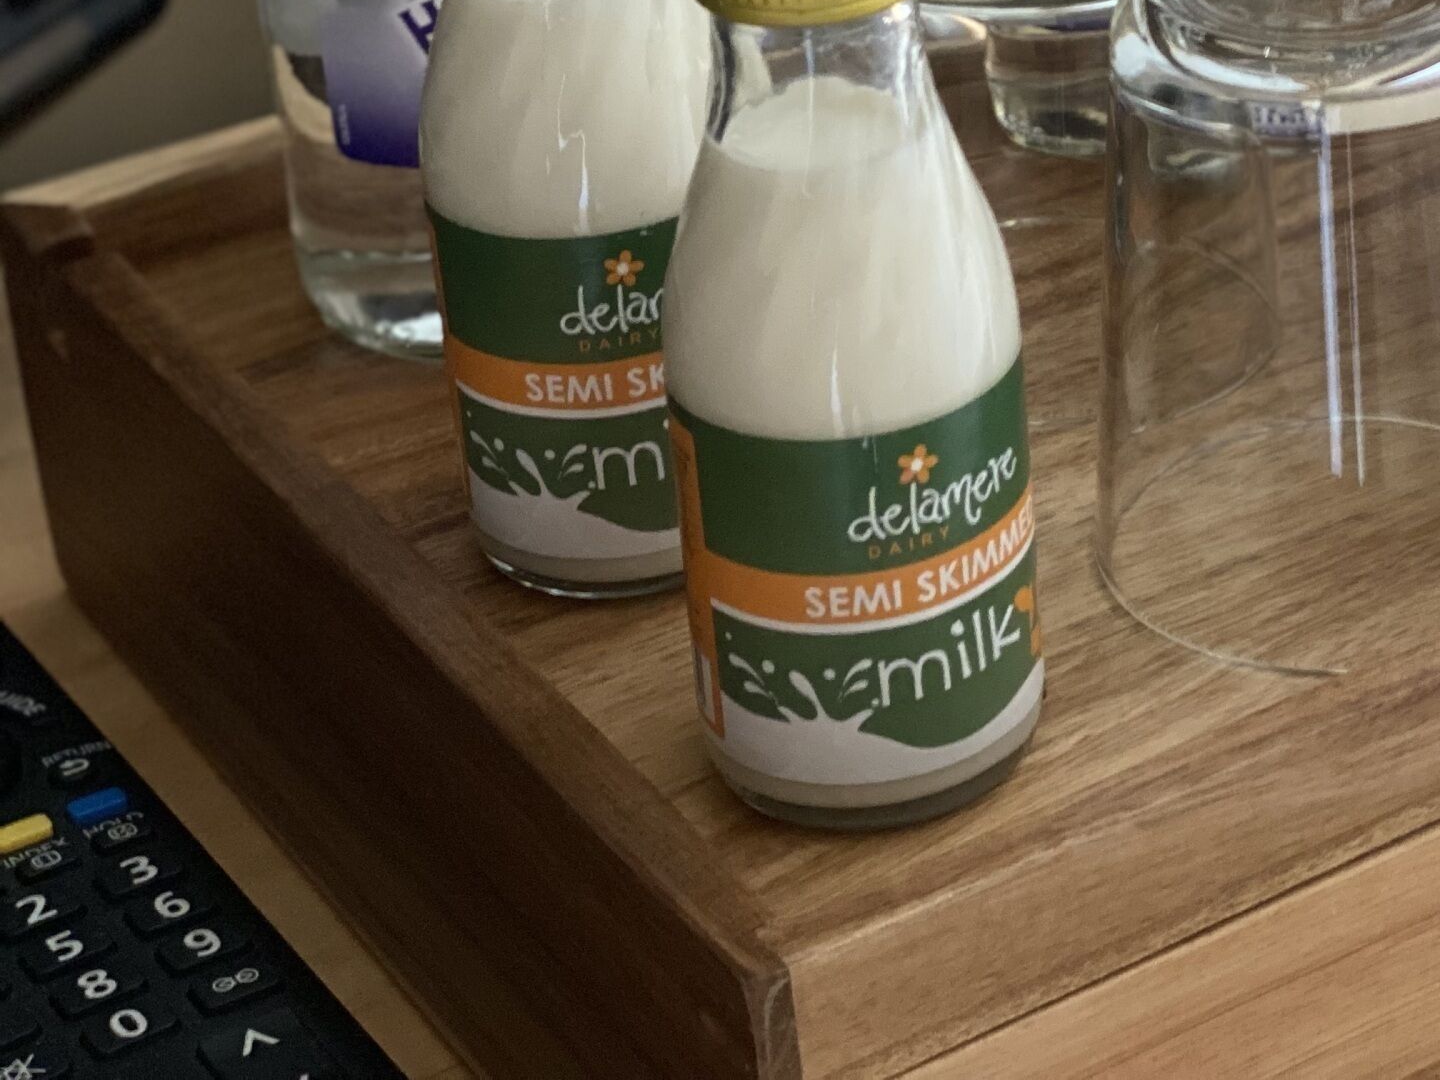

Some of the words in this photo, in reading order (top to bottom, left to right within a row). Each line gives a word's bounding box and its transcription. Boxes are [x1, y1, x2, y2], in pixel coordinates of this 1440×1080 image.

[525, 373, 613, 403] SEMI
[848, 446, 1017, 544] delamere
[868, 526, 952, 560] DAIRY
[804, 580, 903, 619] SEMI
[878, 604, 1021, 708] milk
[119, 855, 158, 885] 3
[16, 894, 58, 925] 2
[154, 891, 190, 919] 6
[45, 930, 83, 962] 5
[183, 928, 221, 957] 9
[77, 969, 117, 999] 8
[109, 1008, 148, 1038] 0
